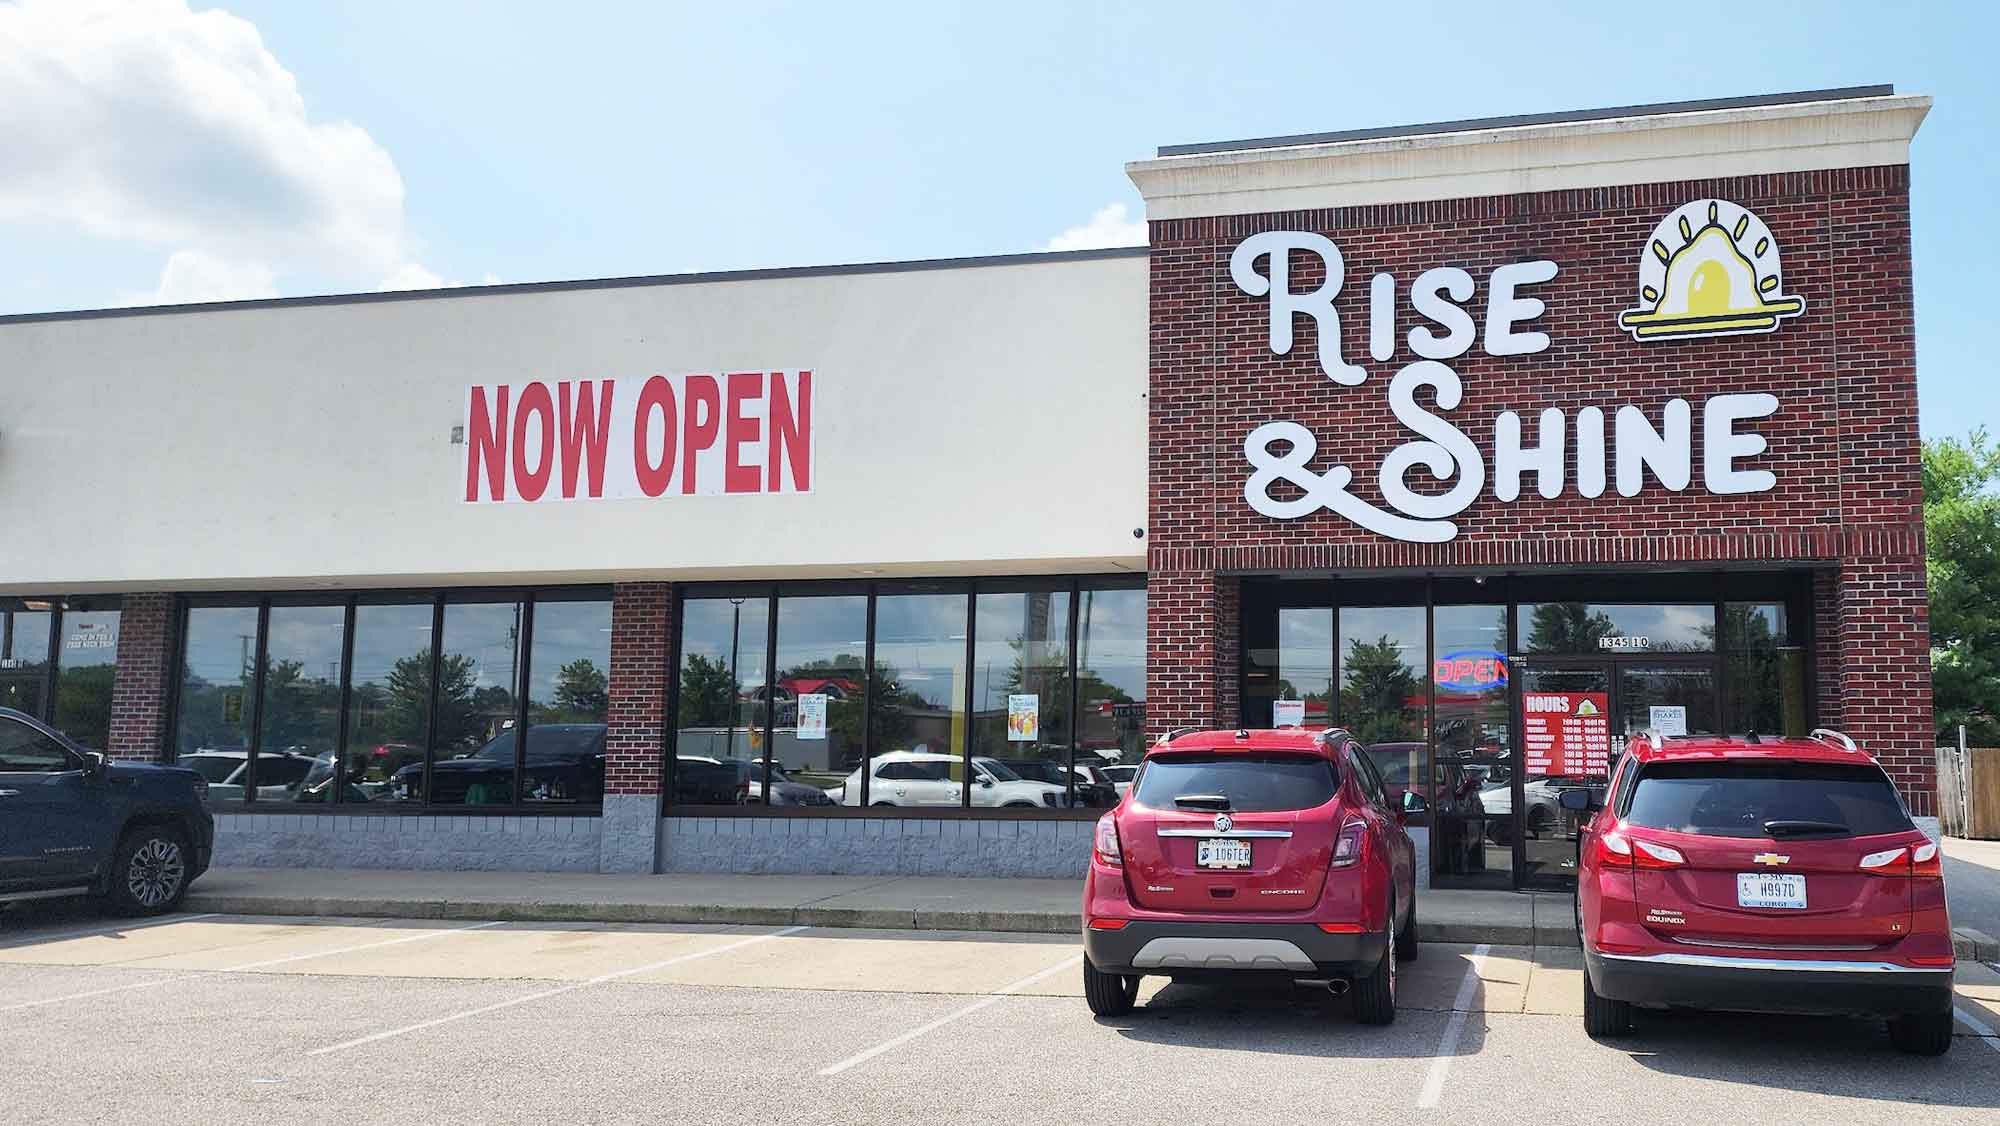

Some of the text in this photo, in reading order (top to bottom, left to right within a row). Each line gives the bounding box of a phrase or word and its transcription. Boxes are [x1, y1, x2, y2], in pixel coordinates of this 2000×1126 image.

[1230, 231, 1559, 386] RISE
[465, 371, 812, 502] NOW OPEN
[1243, 360, 1780, 543] & SHINE
[1600, 637, 1648, 648] 1345 10
[1434, 658, 1509, 683] OPEN
[1526, 696, 1570, 712] HOURS
[1647, 916, 1690, 926] EQUINOX
